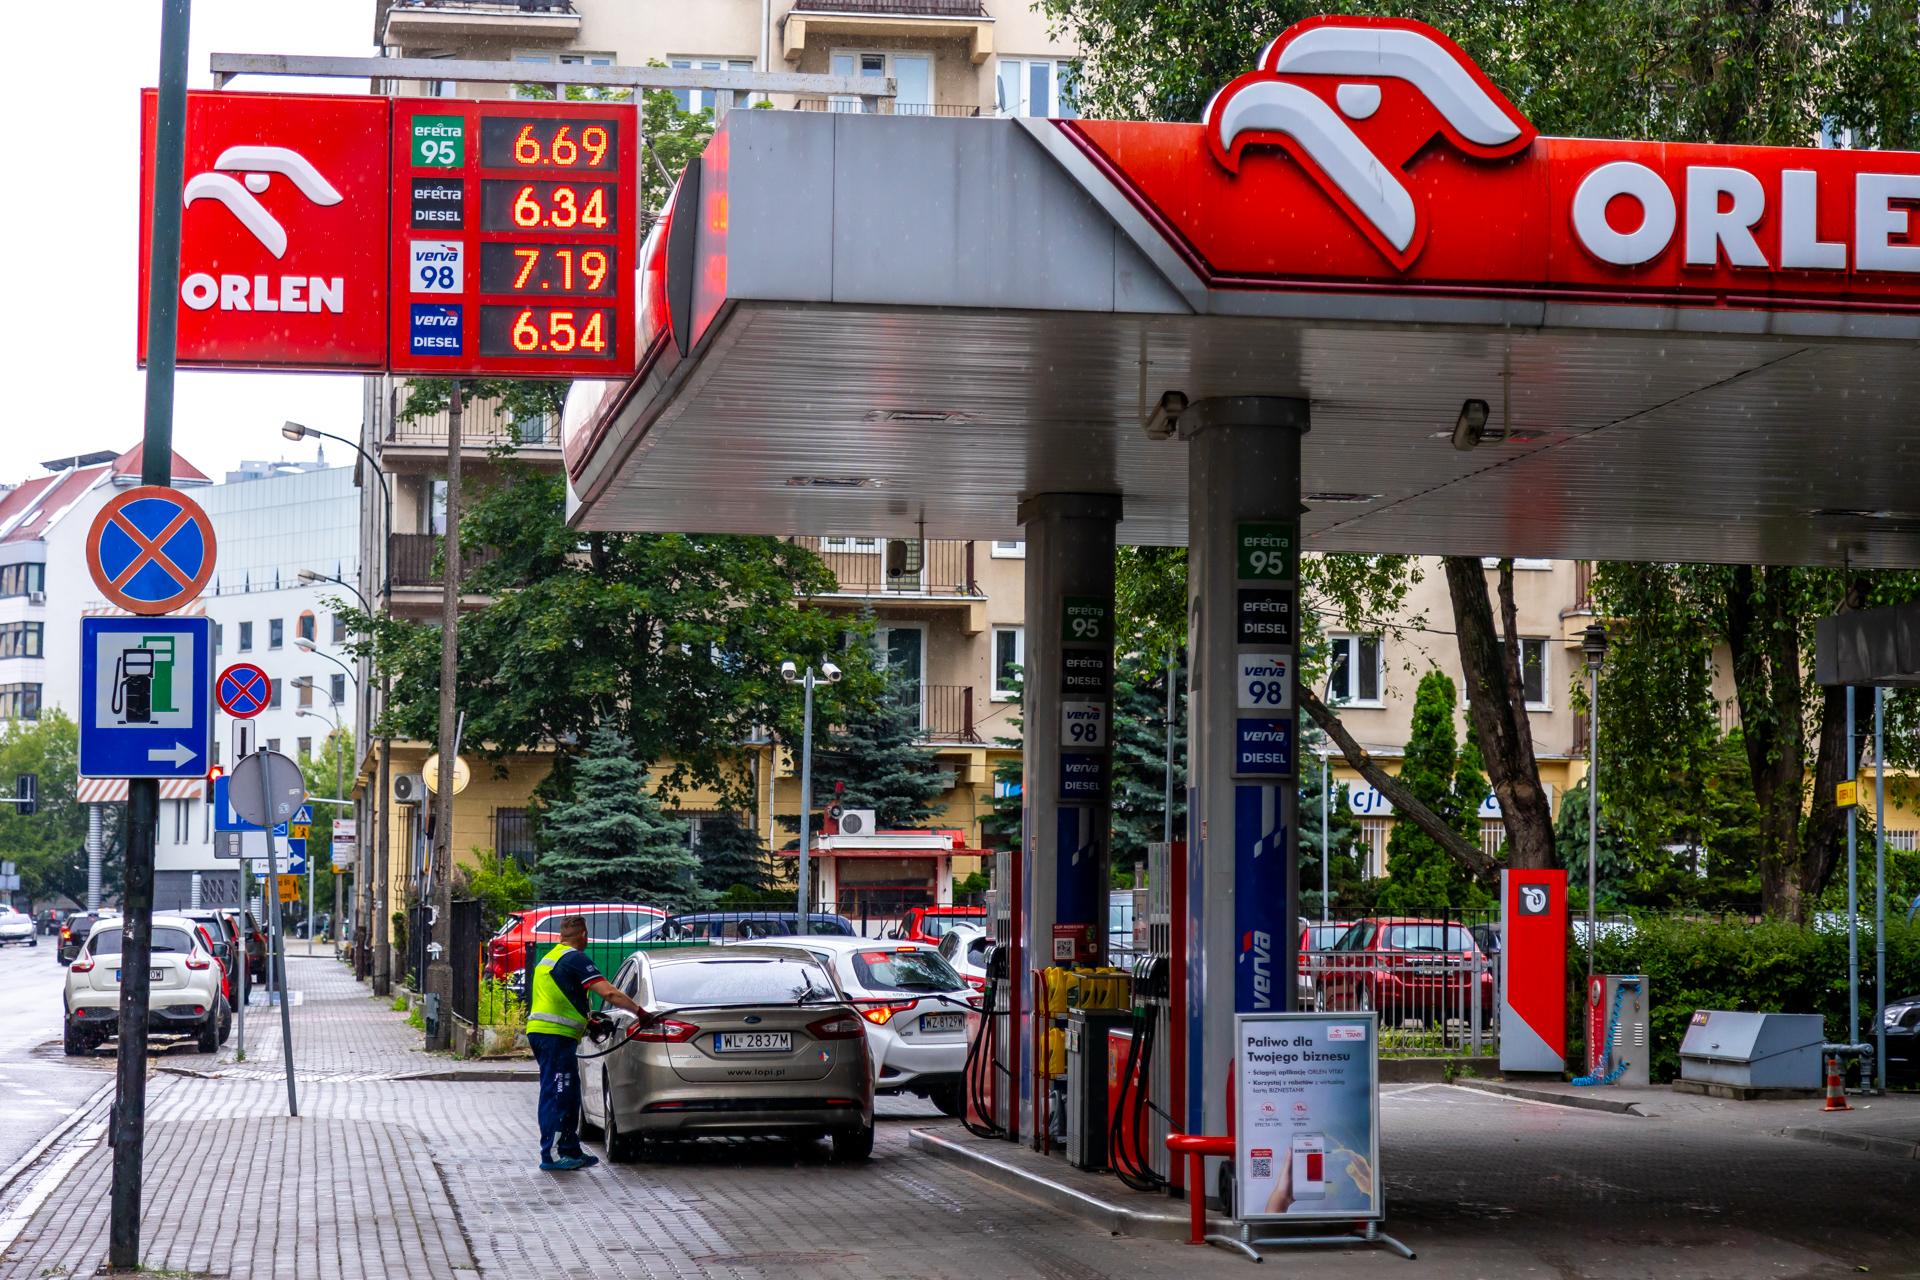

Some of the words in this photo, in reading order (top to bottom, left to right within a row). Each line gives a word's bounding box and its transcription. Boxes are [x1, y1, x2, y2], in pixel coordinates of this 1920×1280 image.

[515, 125, 607, 166] 6.69
[420, 140, 455, 164] 95
[514, 186, 607, 228] 6.34
[416, 210, 460, 221] DIESEL
[1573, 161, 1920, 273] ORLE
[416, 250, 458, 261] verva
[514, 250, 606, 290] 7.19
[420, 266, 454, 289] 98
[181, 272, 344, 313] ORLEN
[415, 315, 458, 326] verva
[513, 311, 605, 352] 6.54
[414, 336, 459, 348] DIESEL
[1250, 551, 1284, 575] 95
[1072, 618, 1099, 637] 95
[1244, 623, 1287, 634] DIESEL
[1245, 667, 1286, 677] verva
[1067, 676, 1102, 685] DIESEL
[1249, 681, 1282, 704] 98
[1067, 712, 1100, 720] verva
[1071, 723, 1097, 742] 98
[1243, 732, 1284, 741] verva
[1243, 753, 1286, 763] DIESEL
[1066, 764, 1099, 773] verva
[1065, 781, 1100, 790] DIESEL
[1254, 930, 1271, 1009] verva
[724, 1035, 740, 1047] WL
[747, 1035, 789, 1047] 2837M
[1247, 1037, 1288, 1047] Paliwo
[1293, 1036, 1312, 1047] dla
[1247, 1052, 1298, 1064] Twojego
[1303, 1051, 1350, 1062] biznesu
[727, 1069, 785, 1077] www.lopi.pl
